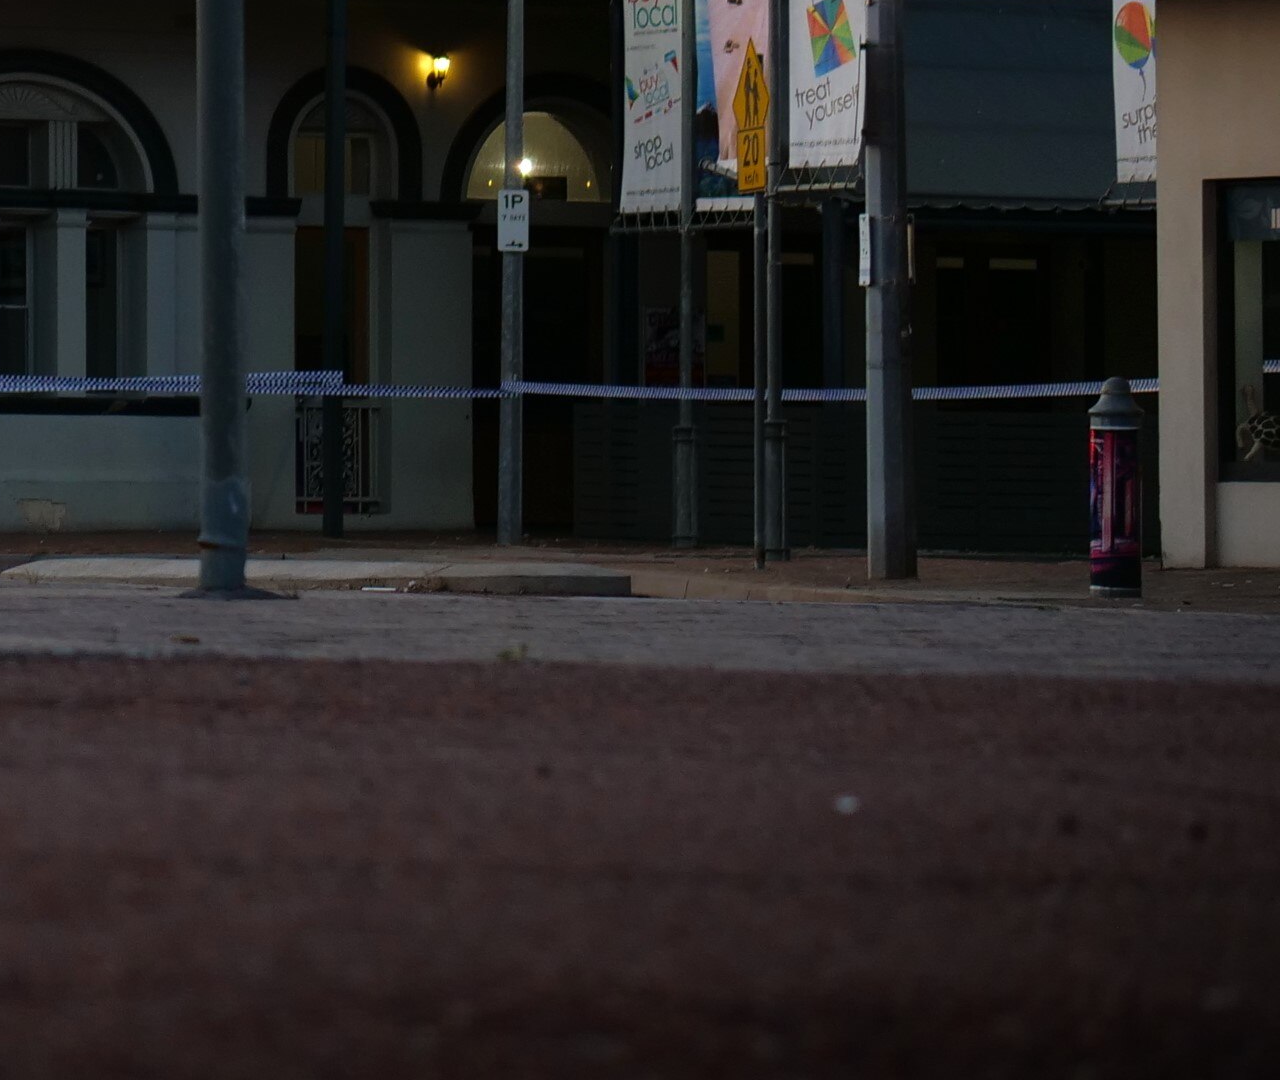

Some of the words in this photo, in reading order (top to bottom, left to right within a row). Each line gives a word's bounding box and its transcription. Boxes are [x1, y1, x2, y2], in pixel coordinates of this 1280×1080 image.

[795, 77, 831, 108] treat
[806, 84, 860, 131] yourself
[634, 134, 662, 160] shop
[644, 142, 674, 172] local
[743, 132, 759, 168] 20
[504, 194, 523, 209] 1P
